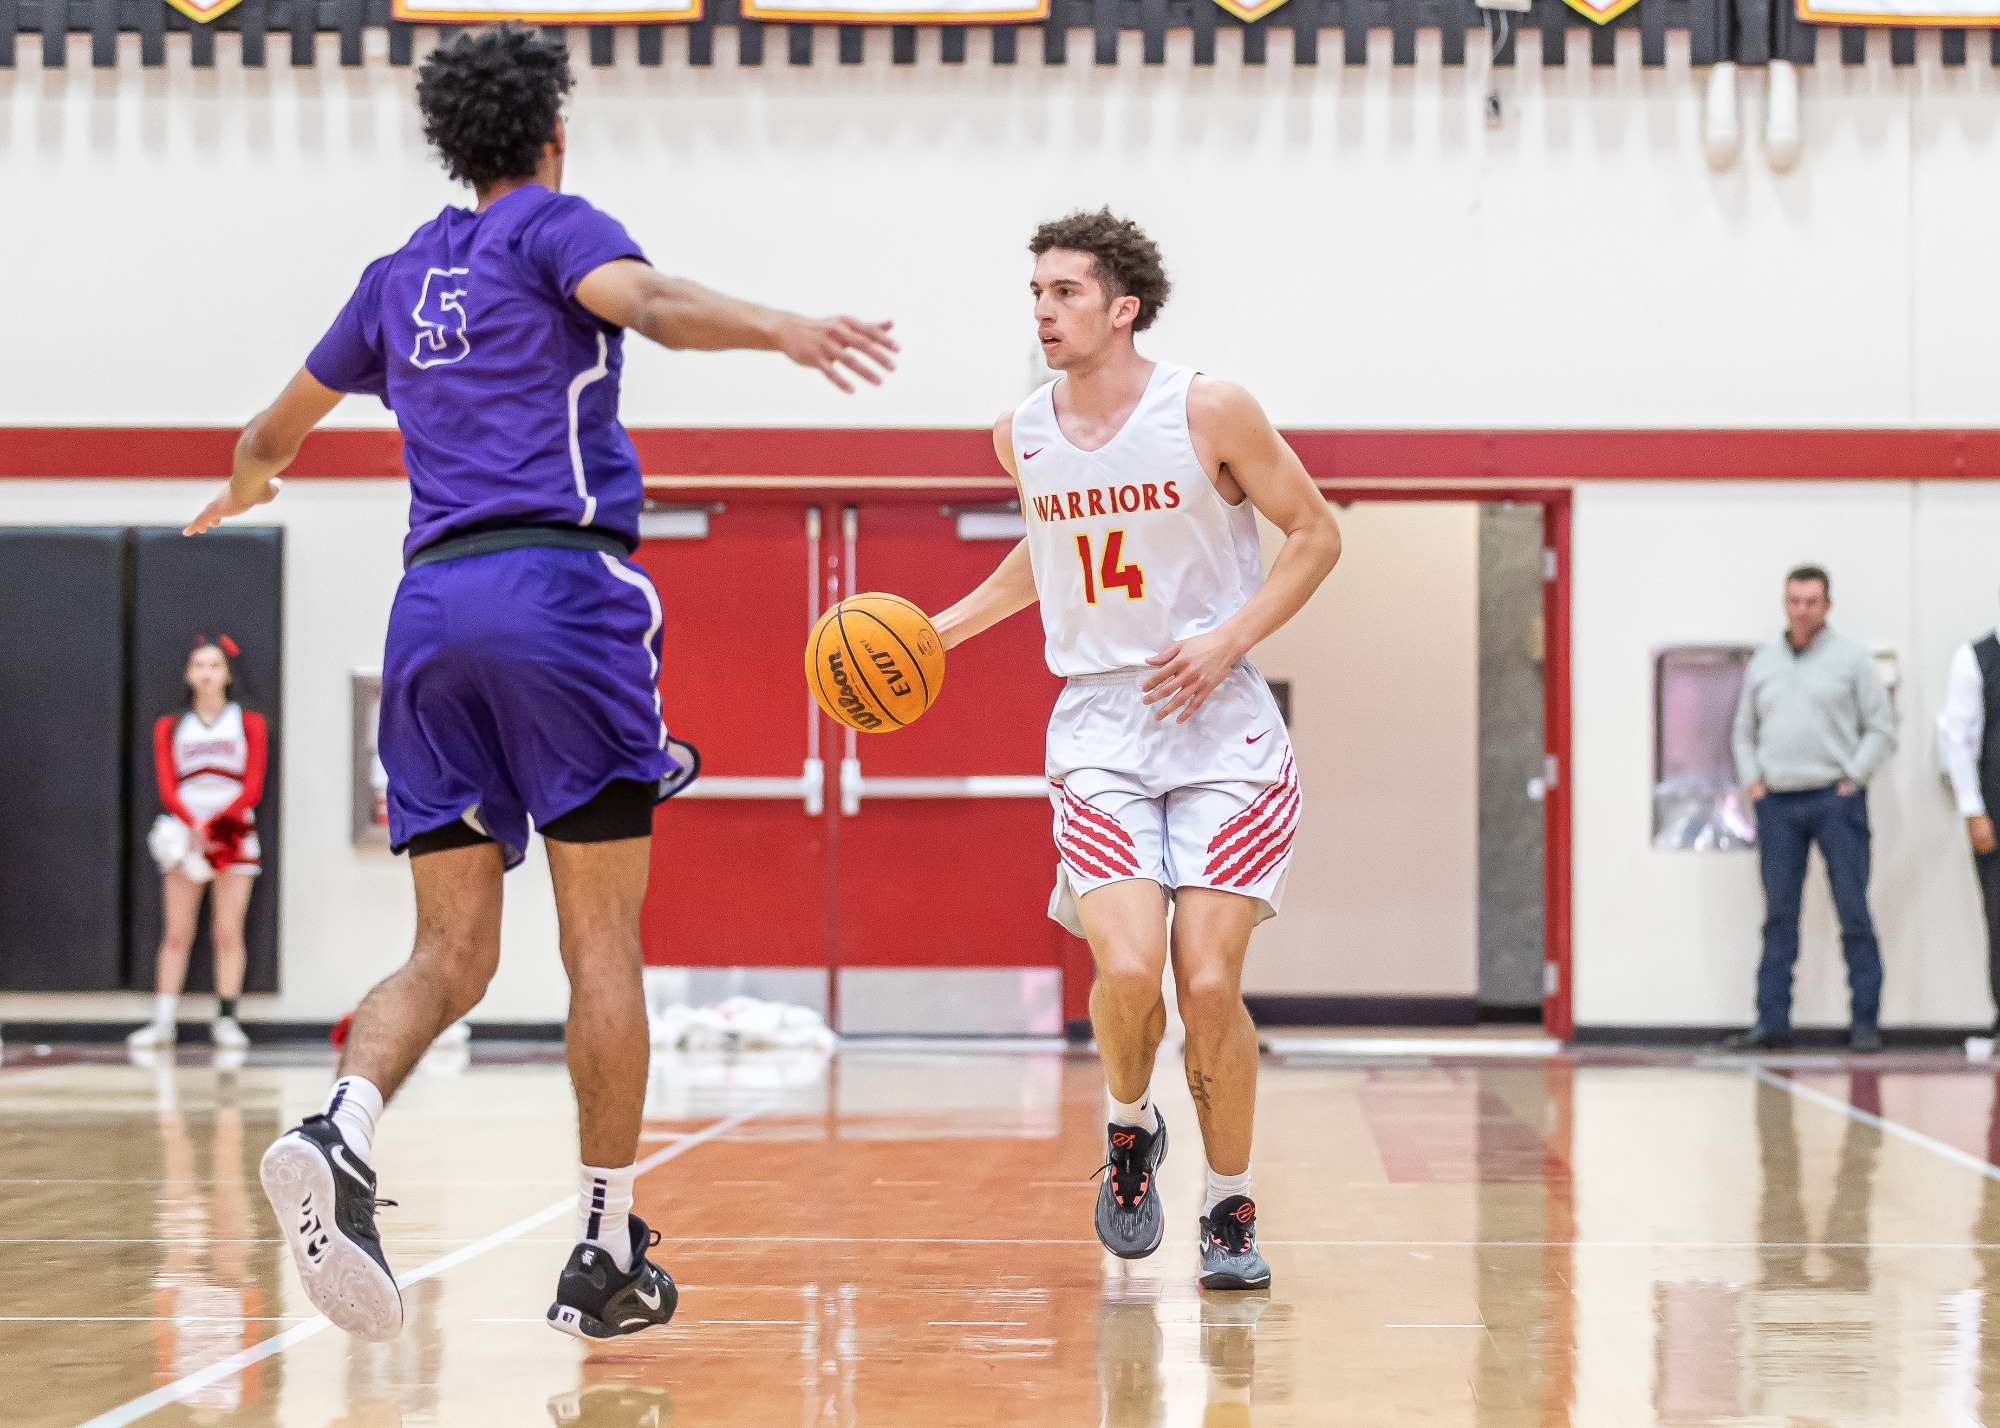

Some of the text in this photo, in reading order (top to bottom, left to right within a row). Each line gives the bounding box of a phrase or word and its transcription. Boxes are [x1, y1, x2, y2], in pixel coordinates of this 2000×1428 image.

[409, 266, 471, 371] 5
[1032, 480, 1181, 523] WARRIORS
[1074, 528, 1145, 606] 14
[828, 651, 883, 730] Wilson
